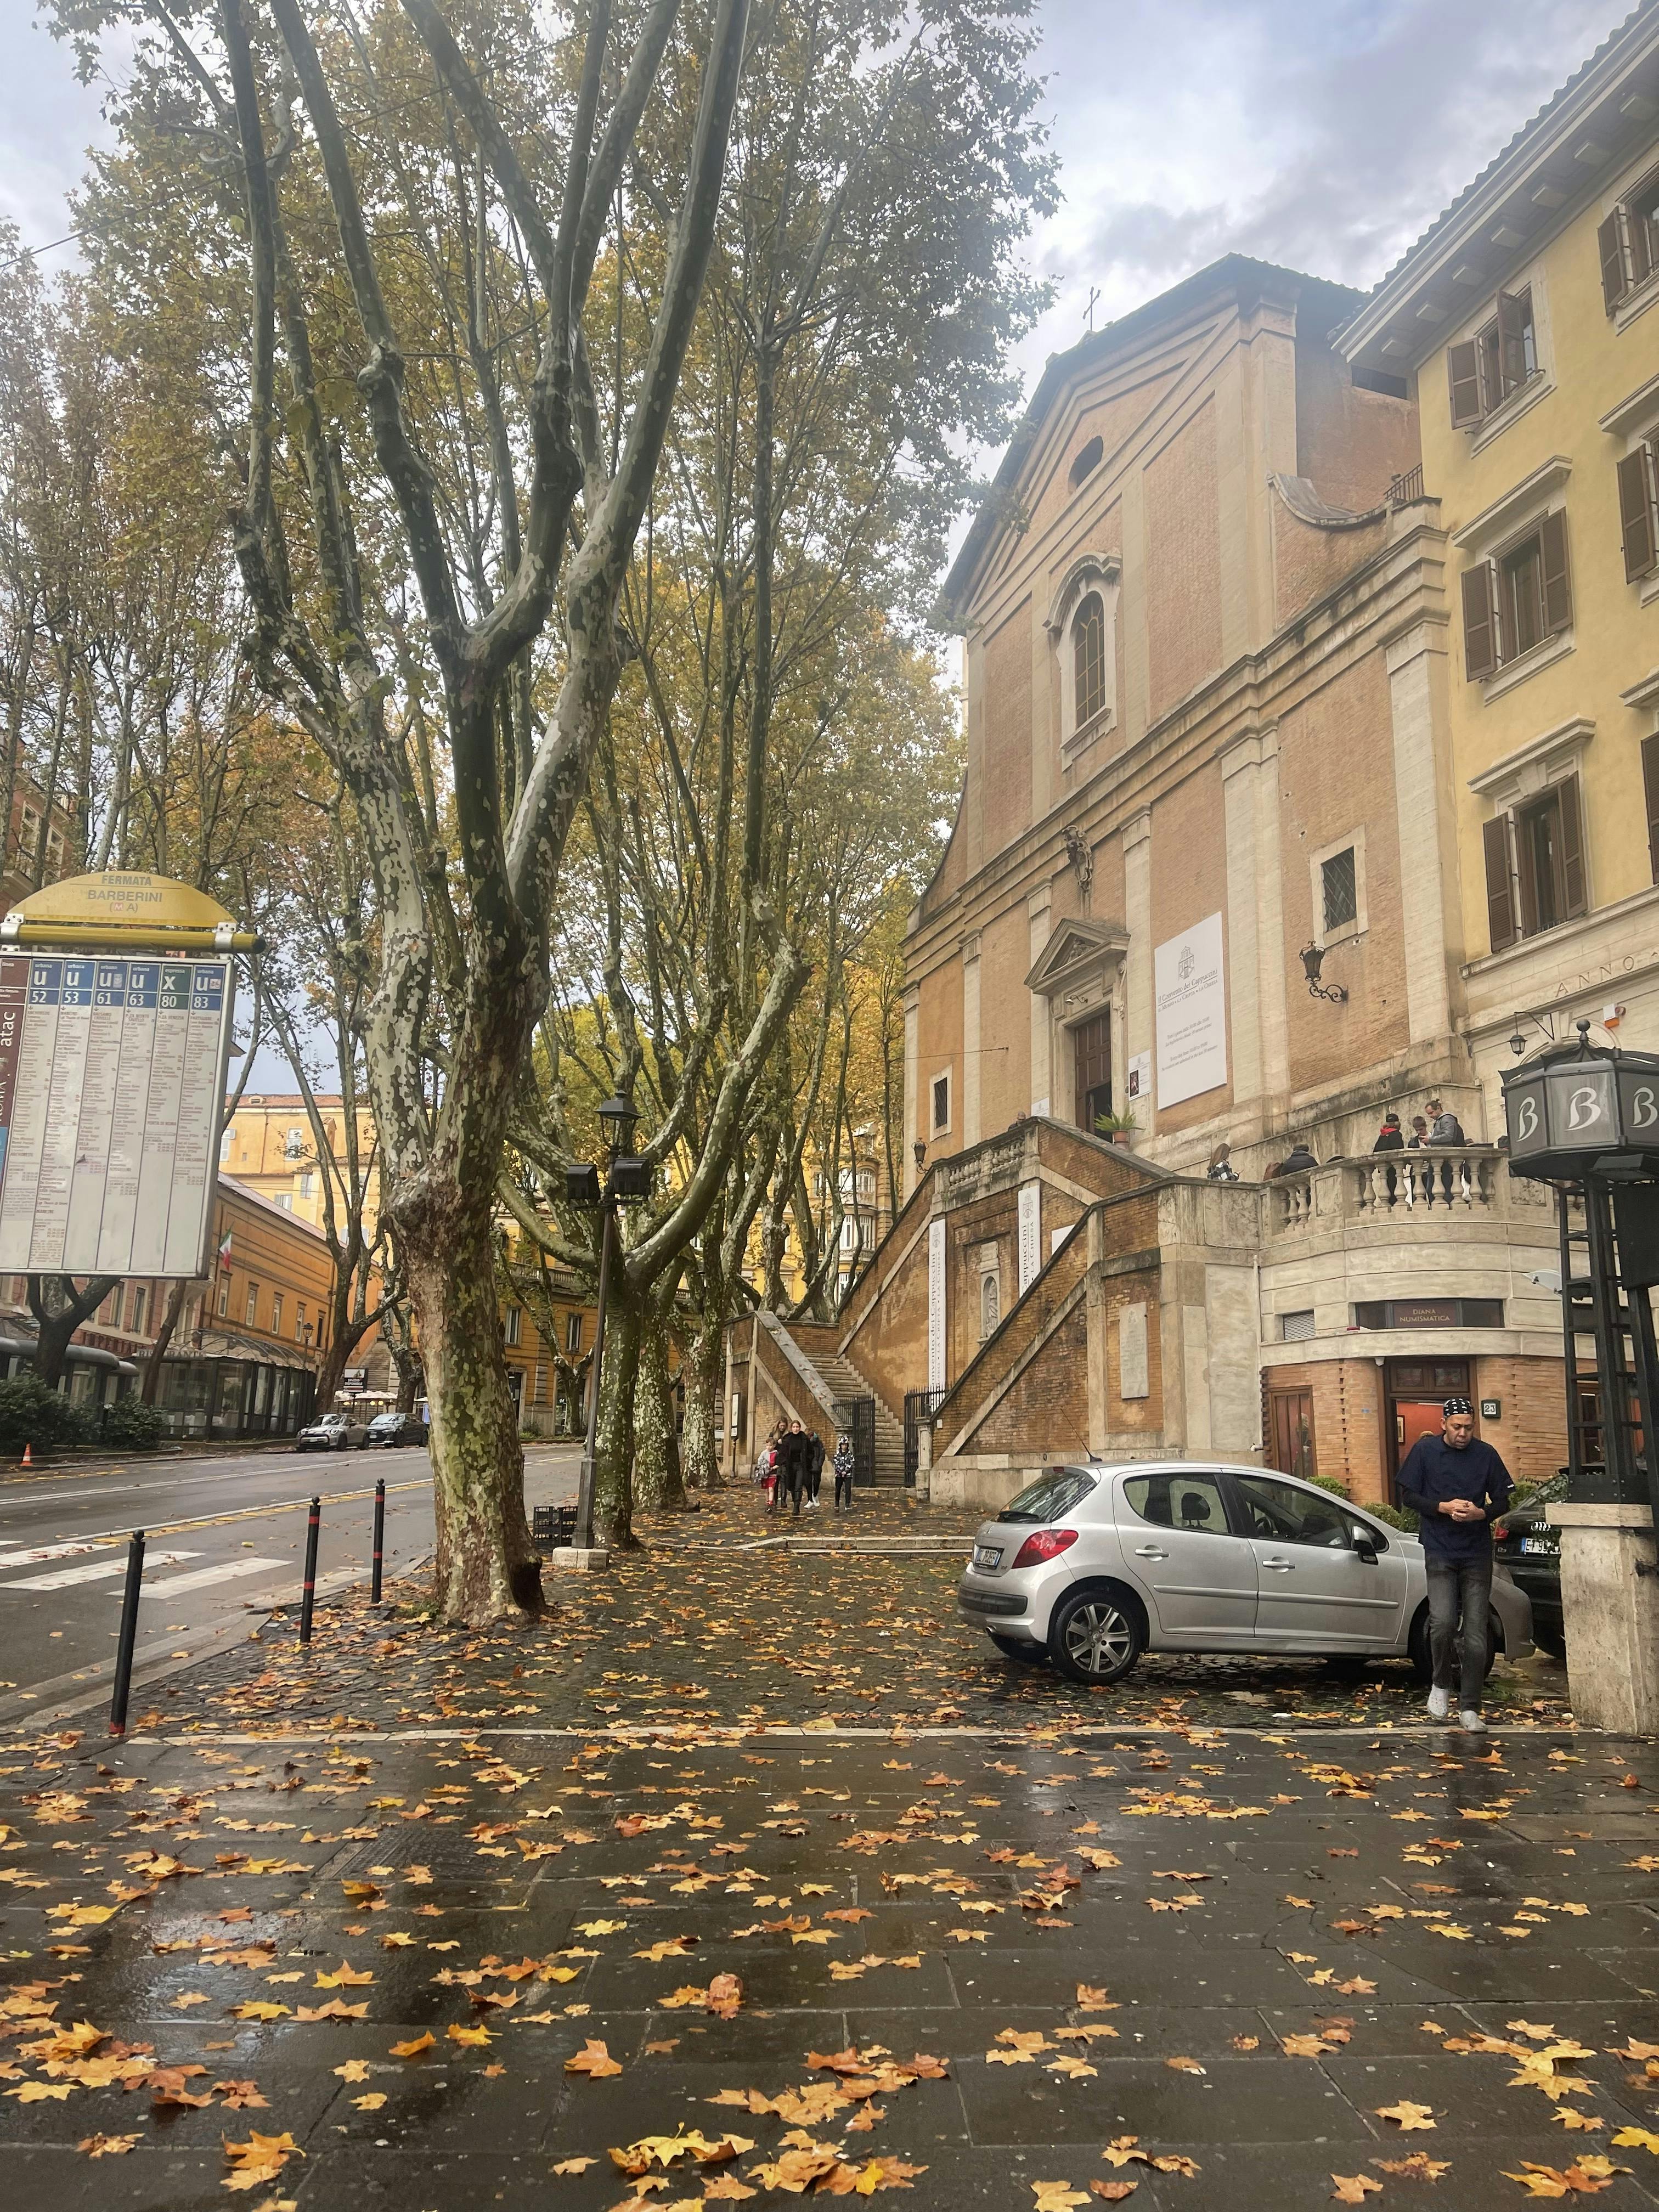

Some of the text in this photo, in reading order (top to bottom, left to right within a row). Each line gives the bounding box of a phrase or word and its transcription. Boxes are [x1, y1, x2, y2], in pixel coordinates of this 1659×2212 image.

[101, 875, 151, 885] FERMATA
[88, 890, 162, 902] BARBERINI
[1555, 956, 1634, 997] ANNO
[1162, 987, 1183, 1001] Convento
[1191, 967, 1217, 986] Cappuccini
[31, 991, 47, 1003] 52
[64, 991, 79, 1003] 53
[97, 992, 111, 1005] 61
[129, 994, 144, 1006] 63
[161, 995, 177, 1008] 80
[194, 996, 208, 1008] 83
[1, 1012, 15, 1047] atac
[1564, 1087, 1601, 1131] B
[1630, 1086, 1658, 1128] B
[1516, 1097, 1538, 1142] B
[1030, 1262, 1034, 1273] LA
[1485, 1404, 1495, 1413] 23
